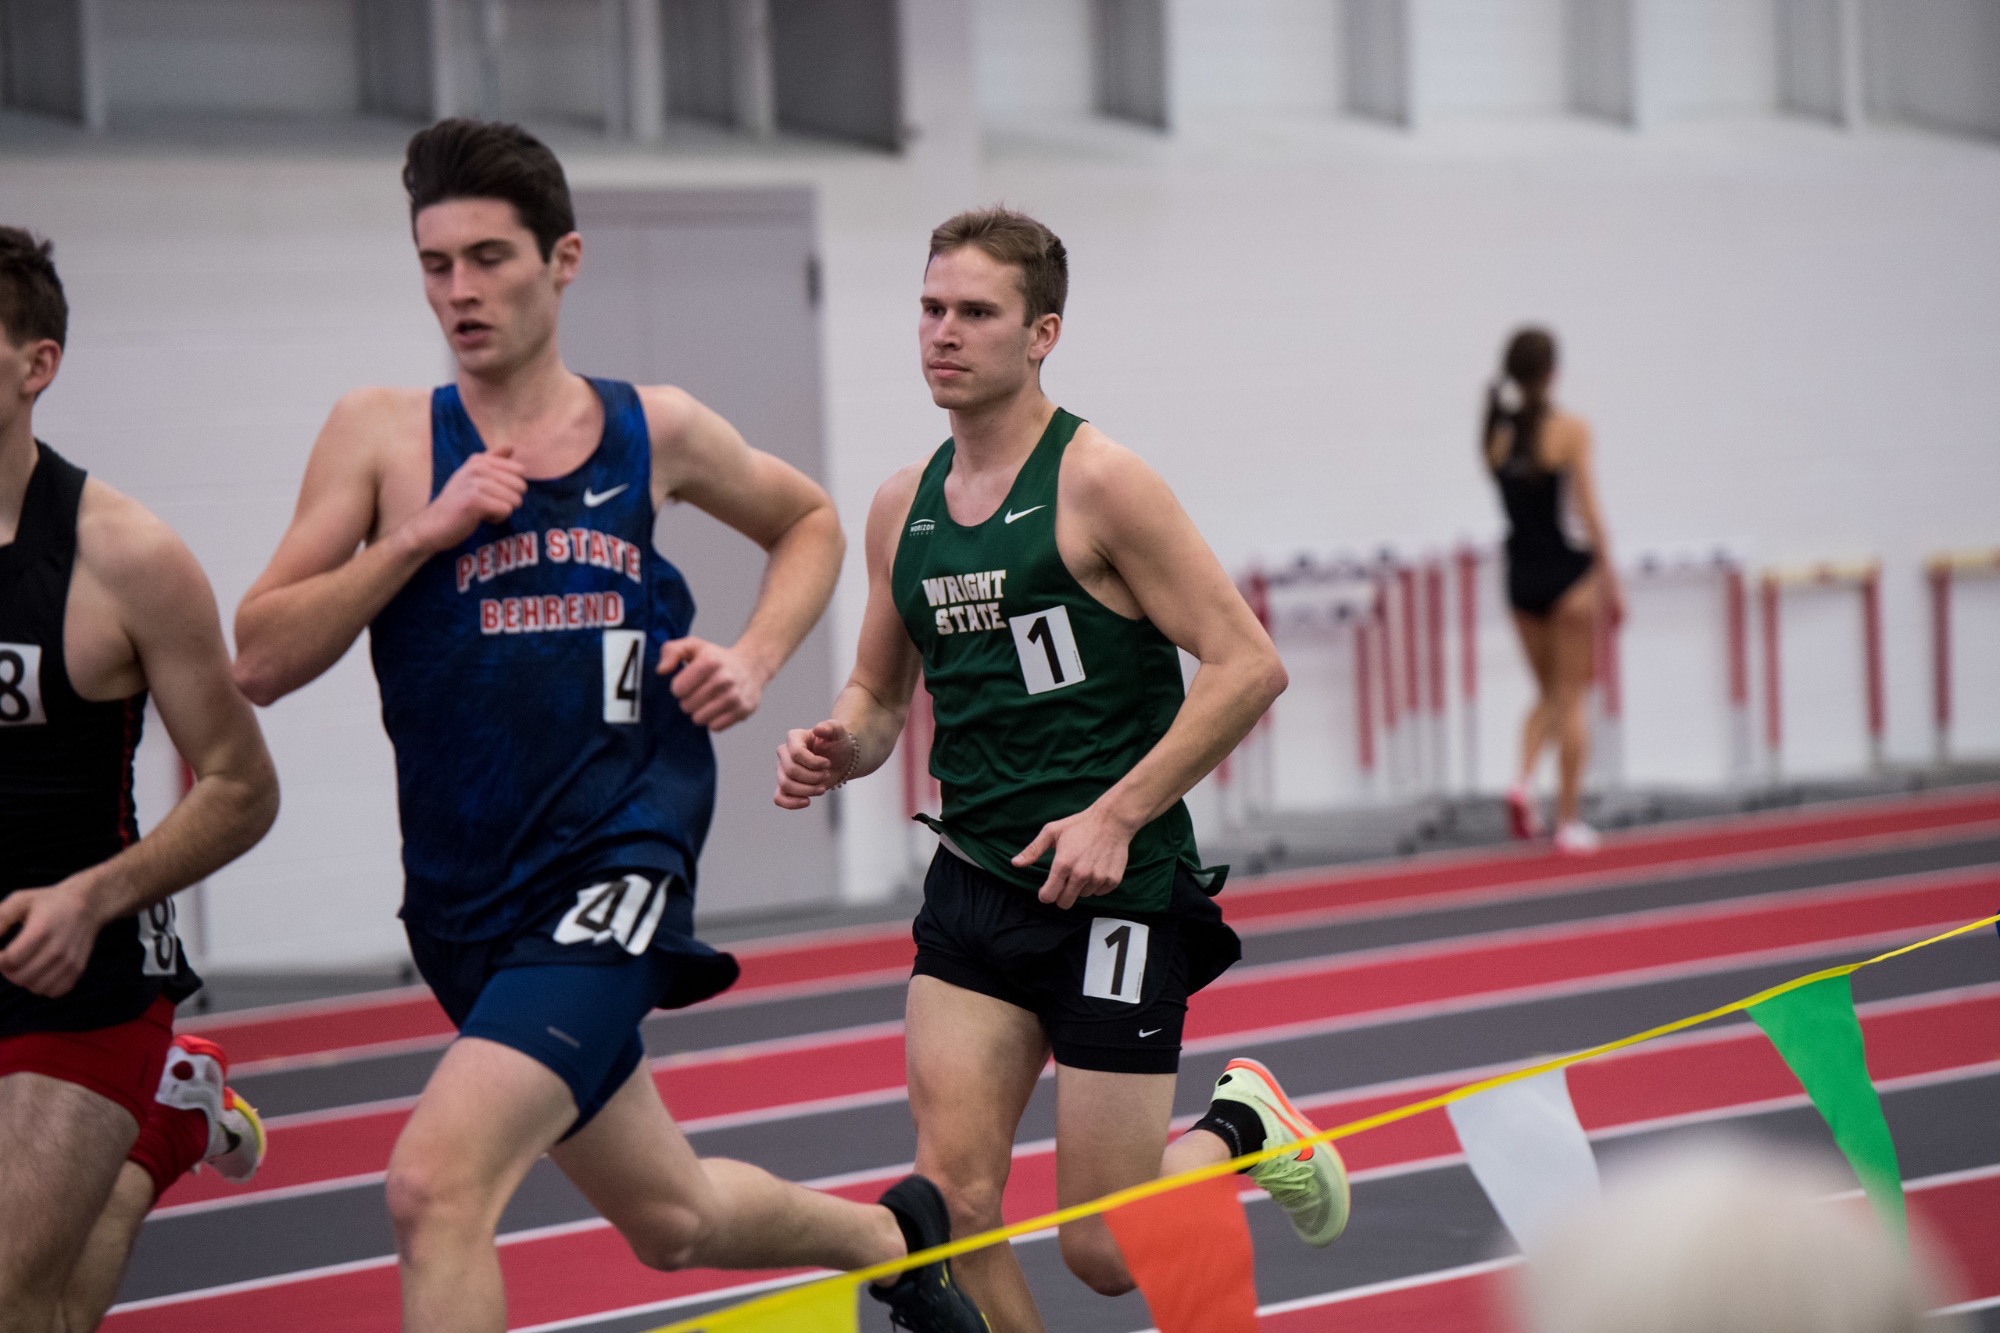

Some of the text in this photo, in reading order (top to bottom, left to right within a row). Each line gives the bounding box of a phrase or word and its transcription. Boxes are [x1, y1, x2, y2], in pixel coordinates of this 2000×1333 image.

[456, 527, 642, 593] PENN STATE
[922, 569, 1006, 607] WRIGHT
[480, 592, 624, 635] BEHREND
[935, 602, 1007, 635] STATE
[616, 638, 640, 718] 4
[1027, 615, 1065, 685] 1
[0, 649, 30, 722] 8
[1104, 925, 1131, 996] 1
